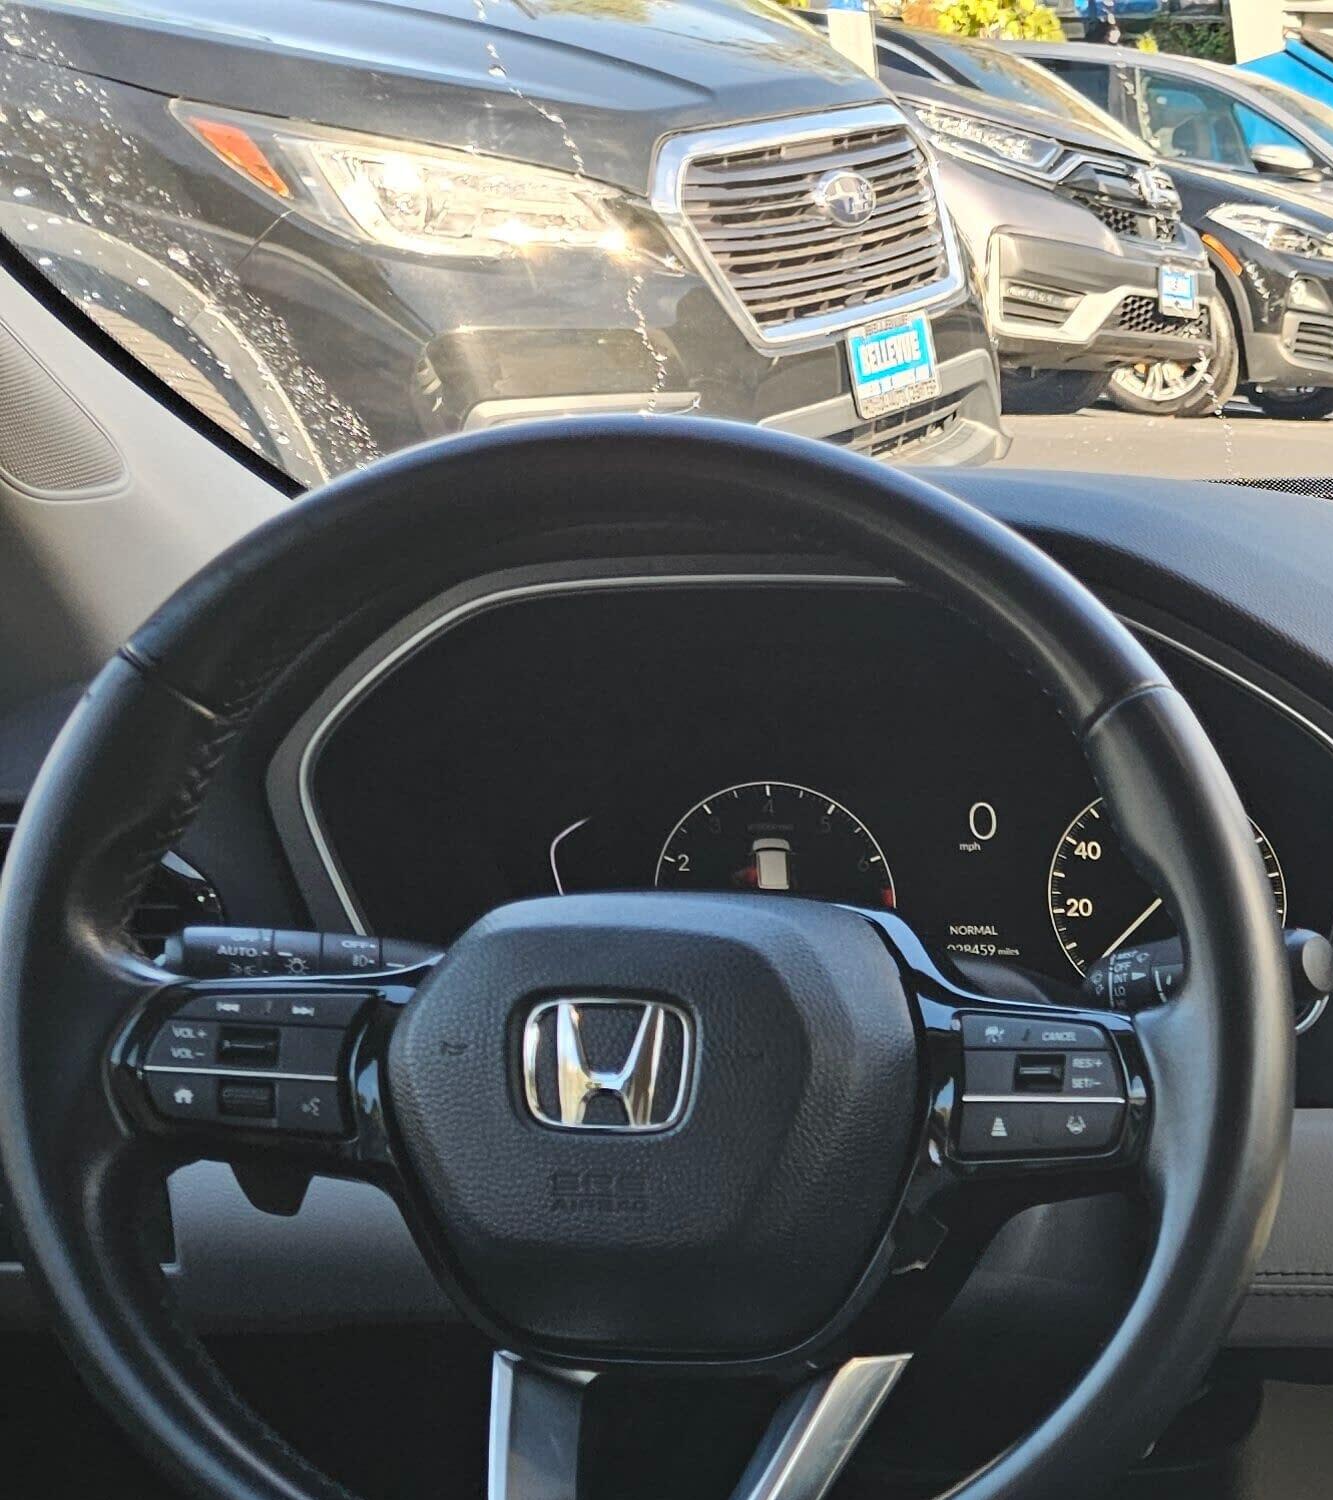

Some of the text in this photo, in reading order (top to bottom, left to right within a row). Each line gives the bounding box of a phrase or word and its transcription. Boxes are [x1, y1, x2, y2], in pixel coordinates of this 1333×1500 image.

[969, 802, 997, 840] 0
[959, 841, 981, 852] mph
[1074, 841, 1101, 860] 40
[677, 854, 690, 871] 2
[1066, 898, 1093, 917] 20
[949, 925, 998, 936] NORMAL
[216, 944, 257, 957] AUTO
[171, 1026, 195, 1039] VOL
[170, 1047, 193, 1059] VOL
